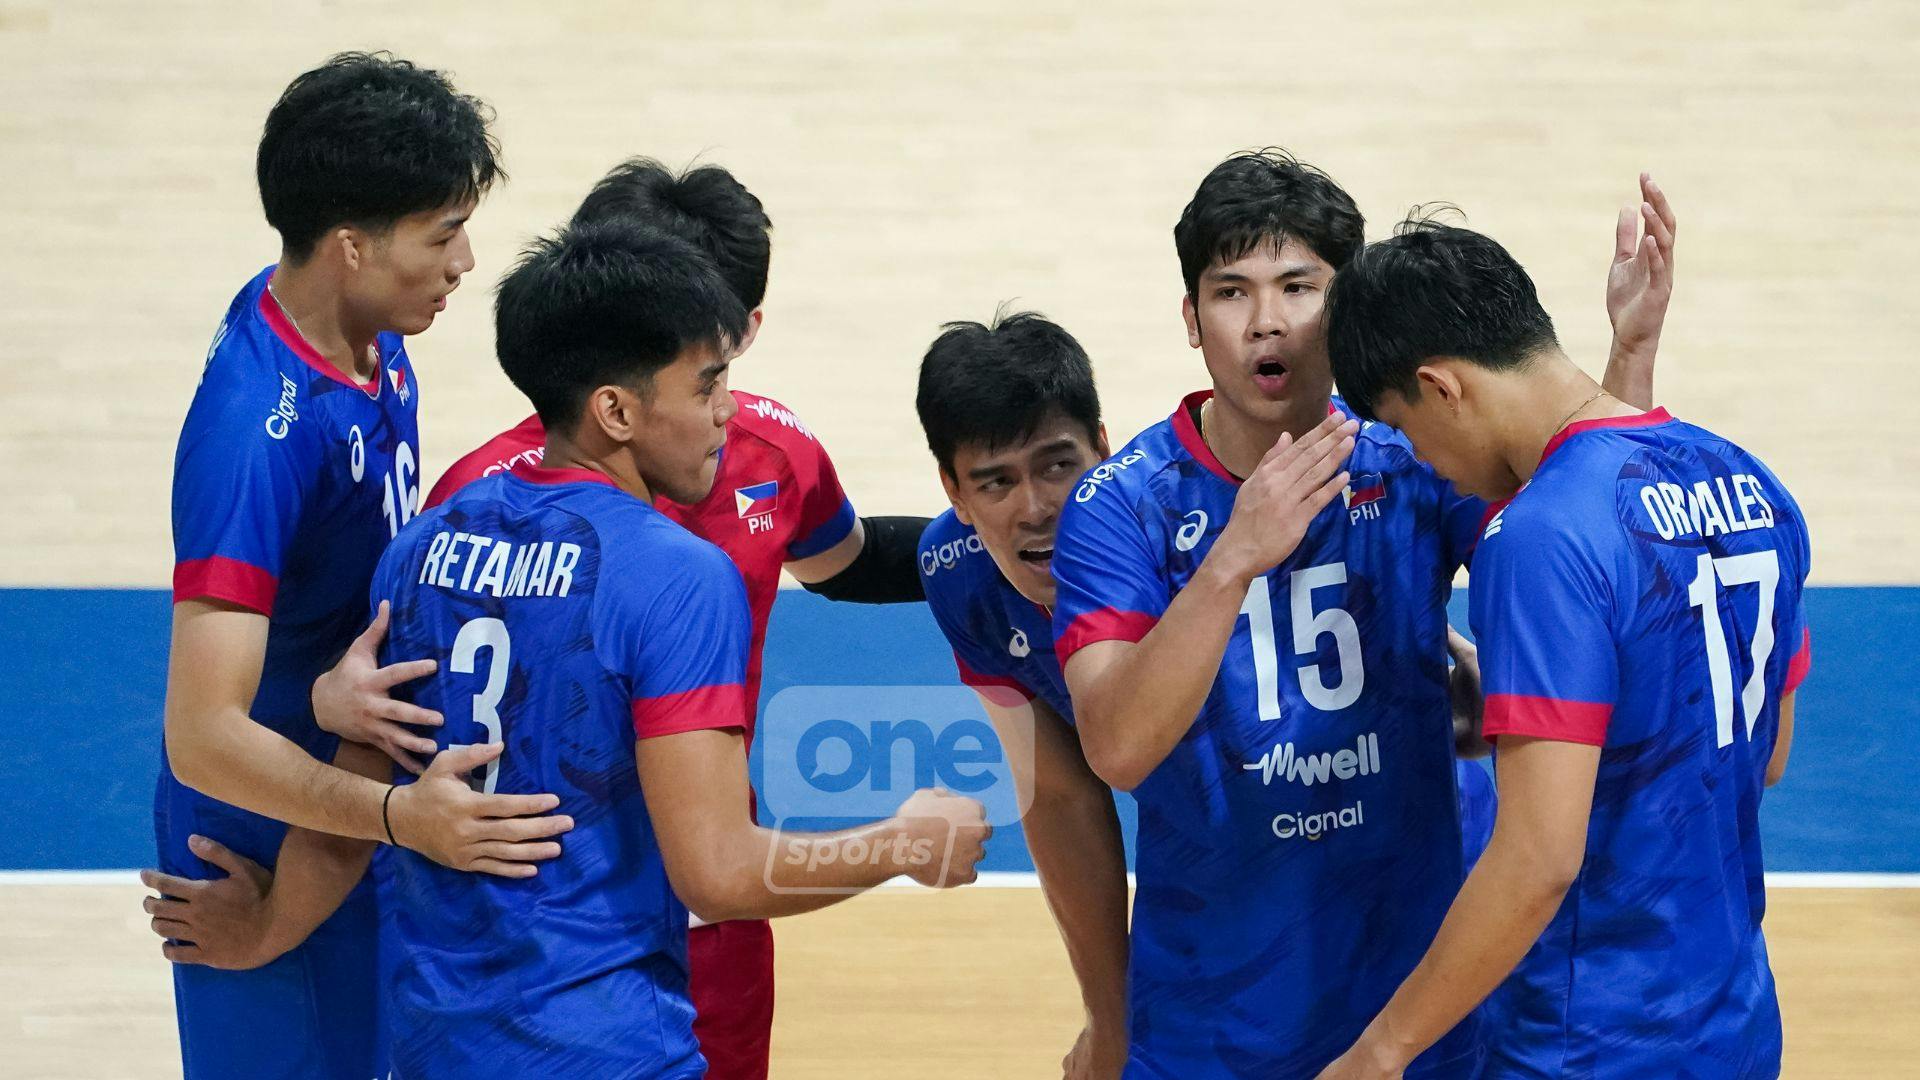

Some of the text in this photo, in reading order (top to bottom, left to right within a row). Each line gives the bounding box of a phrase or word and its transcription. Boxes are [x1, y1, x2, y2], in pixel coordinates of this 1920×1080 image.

[265, 371, 299, 440] Cignal
[1075, 449, 1147, 503] Cignal
[748, 514, 774, 535] PHI
[1349, 502, 1381, 526] PHI
[419, 531, 582, 598] RETAMAR
[921, 534, 984, 576] Cigna
[1239, 561, 1365, 722] 15
[1688, 549, 1780, 750] 17
[448, 617, 511, 796] 3
[1242, 732, 1381, 787] Mwell
[1272, 800, 1364, 841] Cignal
